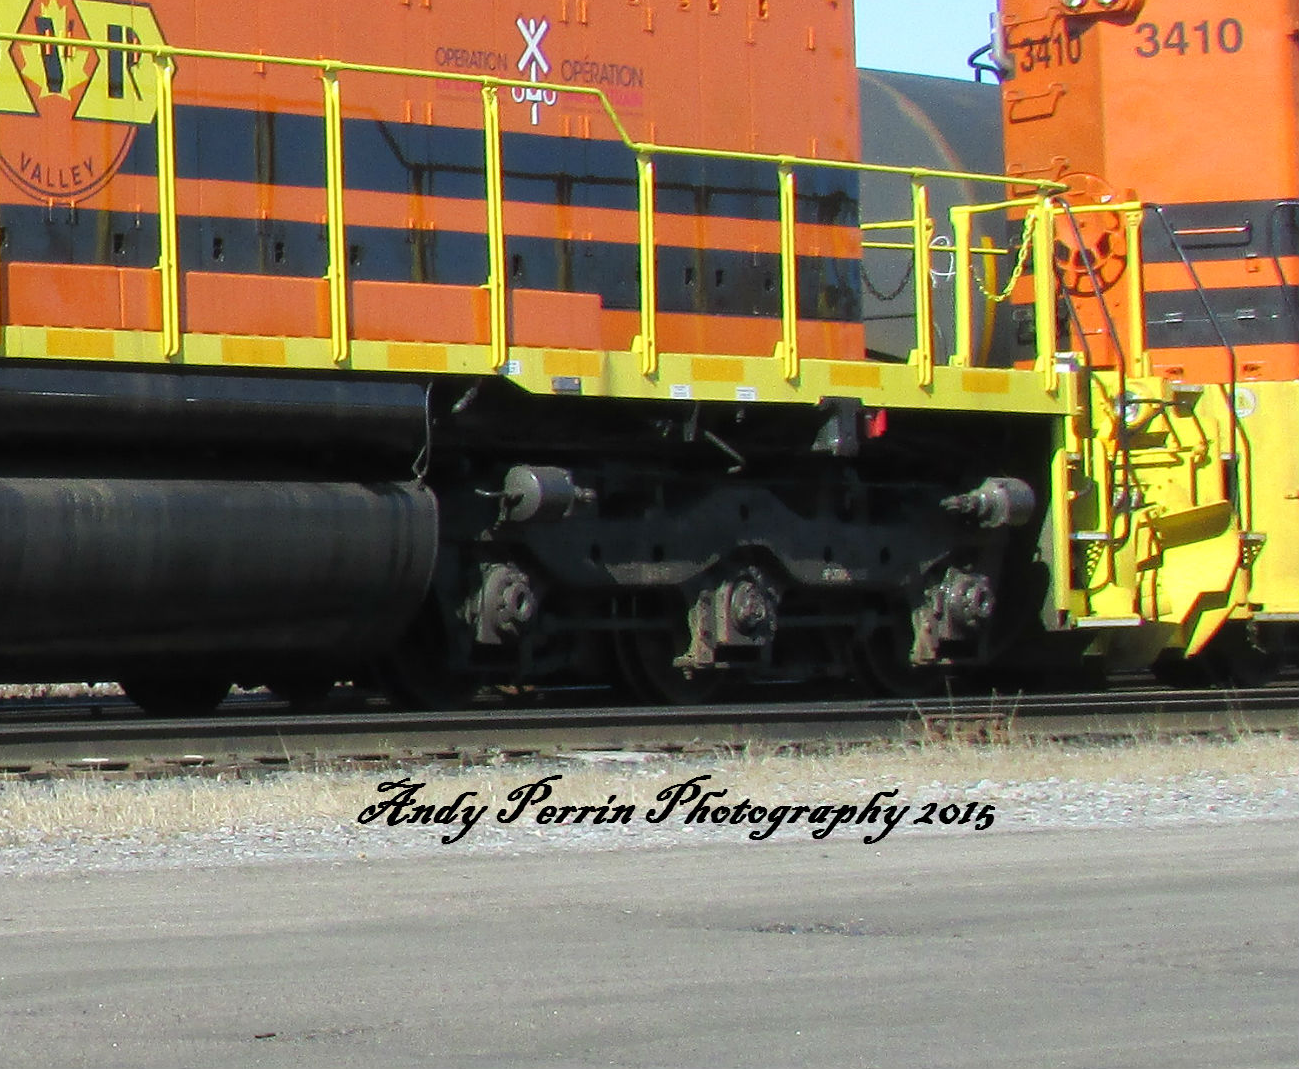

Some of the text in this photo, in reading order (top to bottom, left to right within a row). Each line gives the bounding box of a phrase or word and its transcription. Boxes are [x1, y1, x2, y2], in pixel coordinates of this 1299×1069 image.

[1020, 32, 1082, 73] 3410
[1136, 17, 1244, 58] 3410
[435, 47, 508, 71] OPERATION
[560, 55, 645, 88] OPÉRATION
[19, 150, 95, 188] VALLEY
